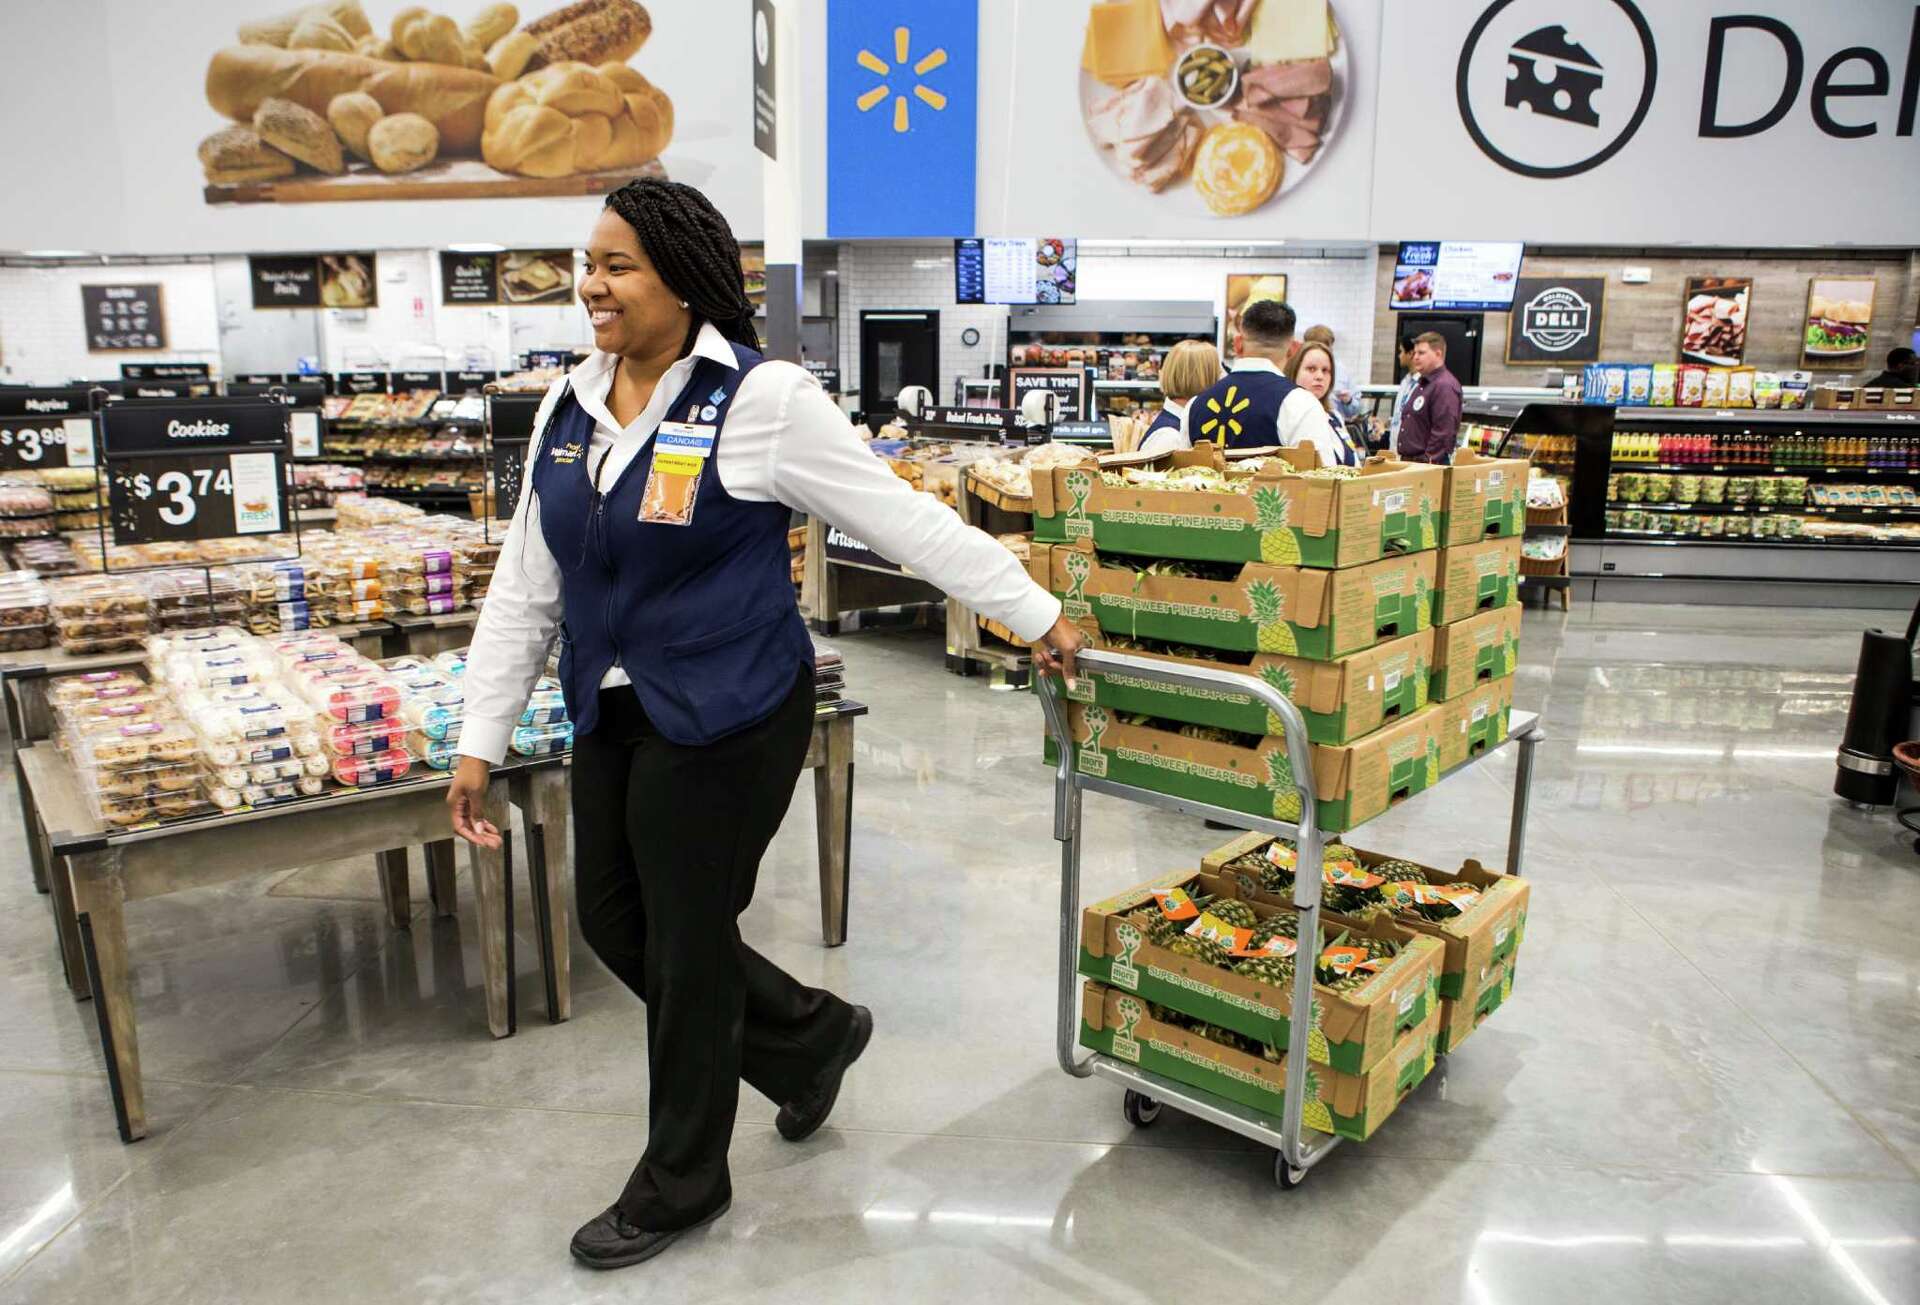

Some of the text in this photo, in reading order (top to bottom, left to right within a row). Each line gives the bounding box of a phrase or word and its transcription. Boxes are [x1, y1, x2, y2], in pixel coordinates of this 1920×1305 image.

[1535, 312, 1578, 326] DELI
[1016, 377, 1078, 388] SAVE TIME
[168, 420, 230, 438] Cookies
[1053, 426, 1071, 434] rab
[1102, 510, 1135, 523] SUPER
[1137, 512, 1173, 526] SWEET
[1174, 515, 1244, 531] PINEAPPLES
[1066, 525, 1089, 536] more
[1065, 605, 1088, 617] more
[1099, 593, 1240, 623] SUPER SWEET PINEAPPLES
[1080, 755, 1105, 769] more
[1117, 747, 1258, 789] SUPER SWEET PINEAPPLES
[1112, 967, 1136, 980] more
[1147, 964, 1281, 1020] SUPER SWEET PINEAPPLES
[1114, 1040, 1137, 1054] more
[1148, 1039, 1281, 1095] SUPER SWEET PINEAPPLES
